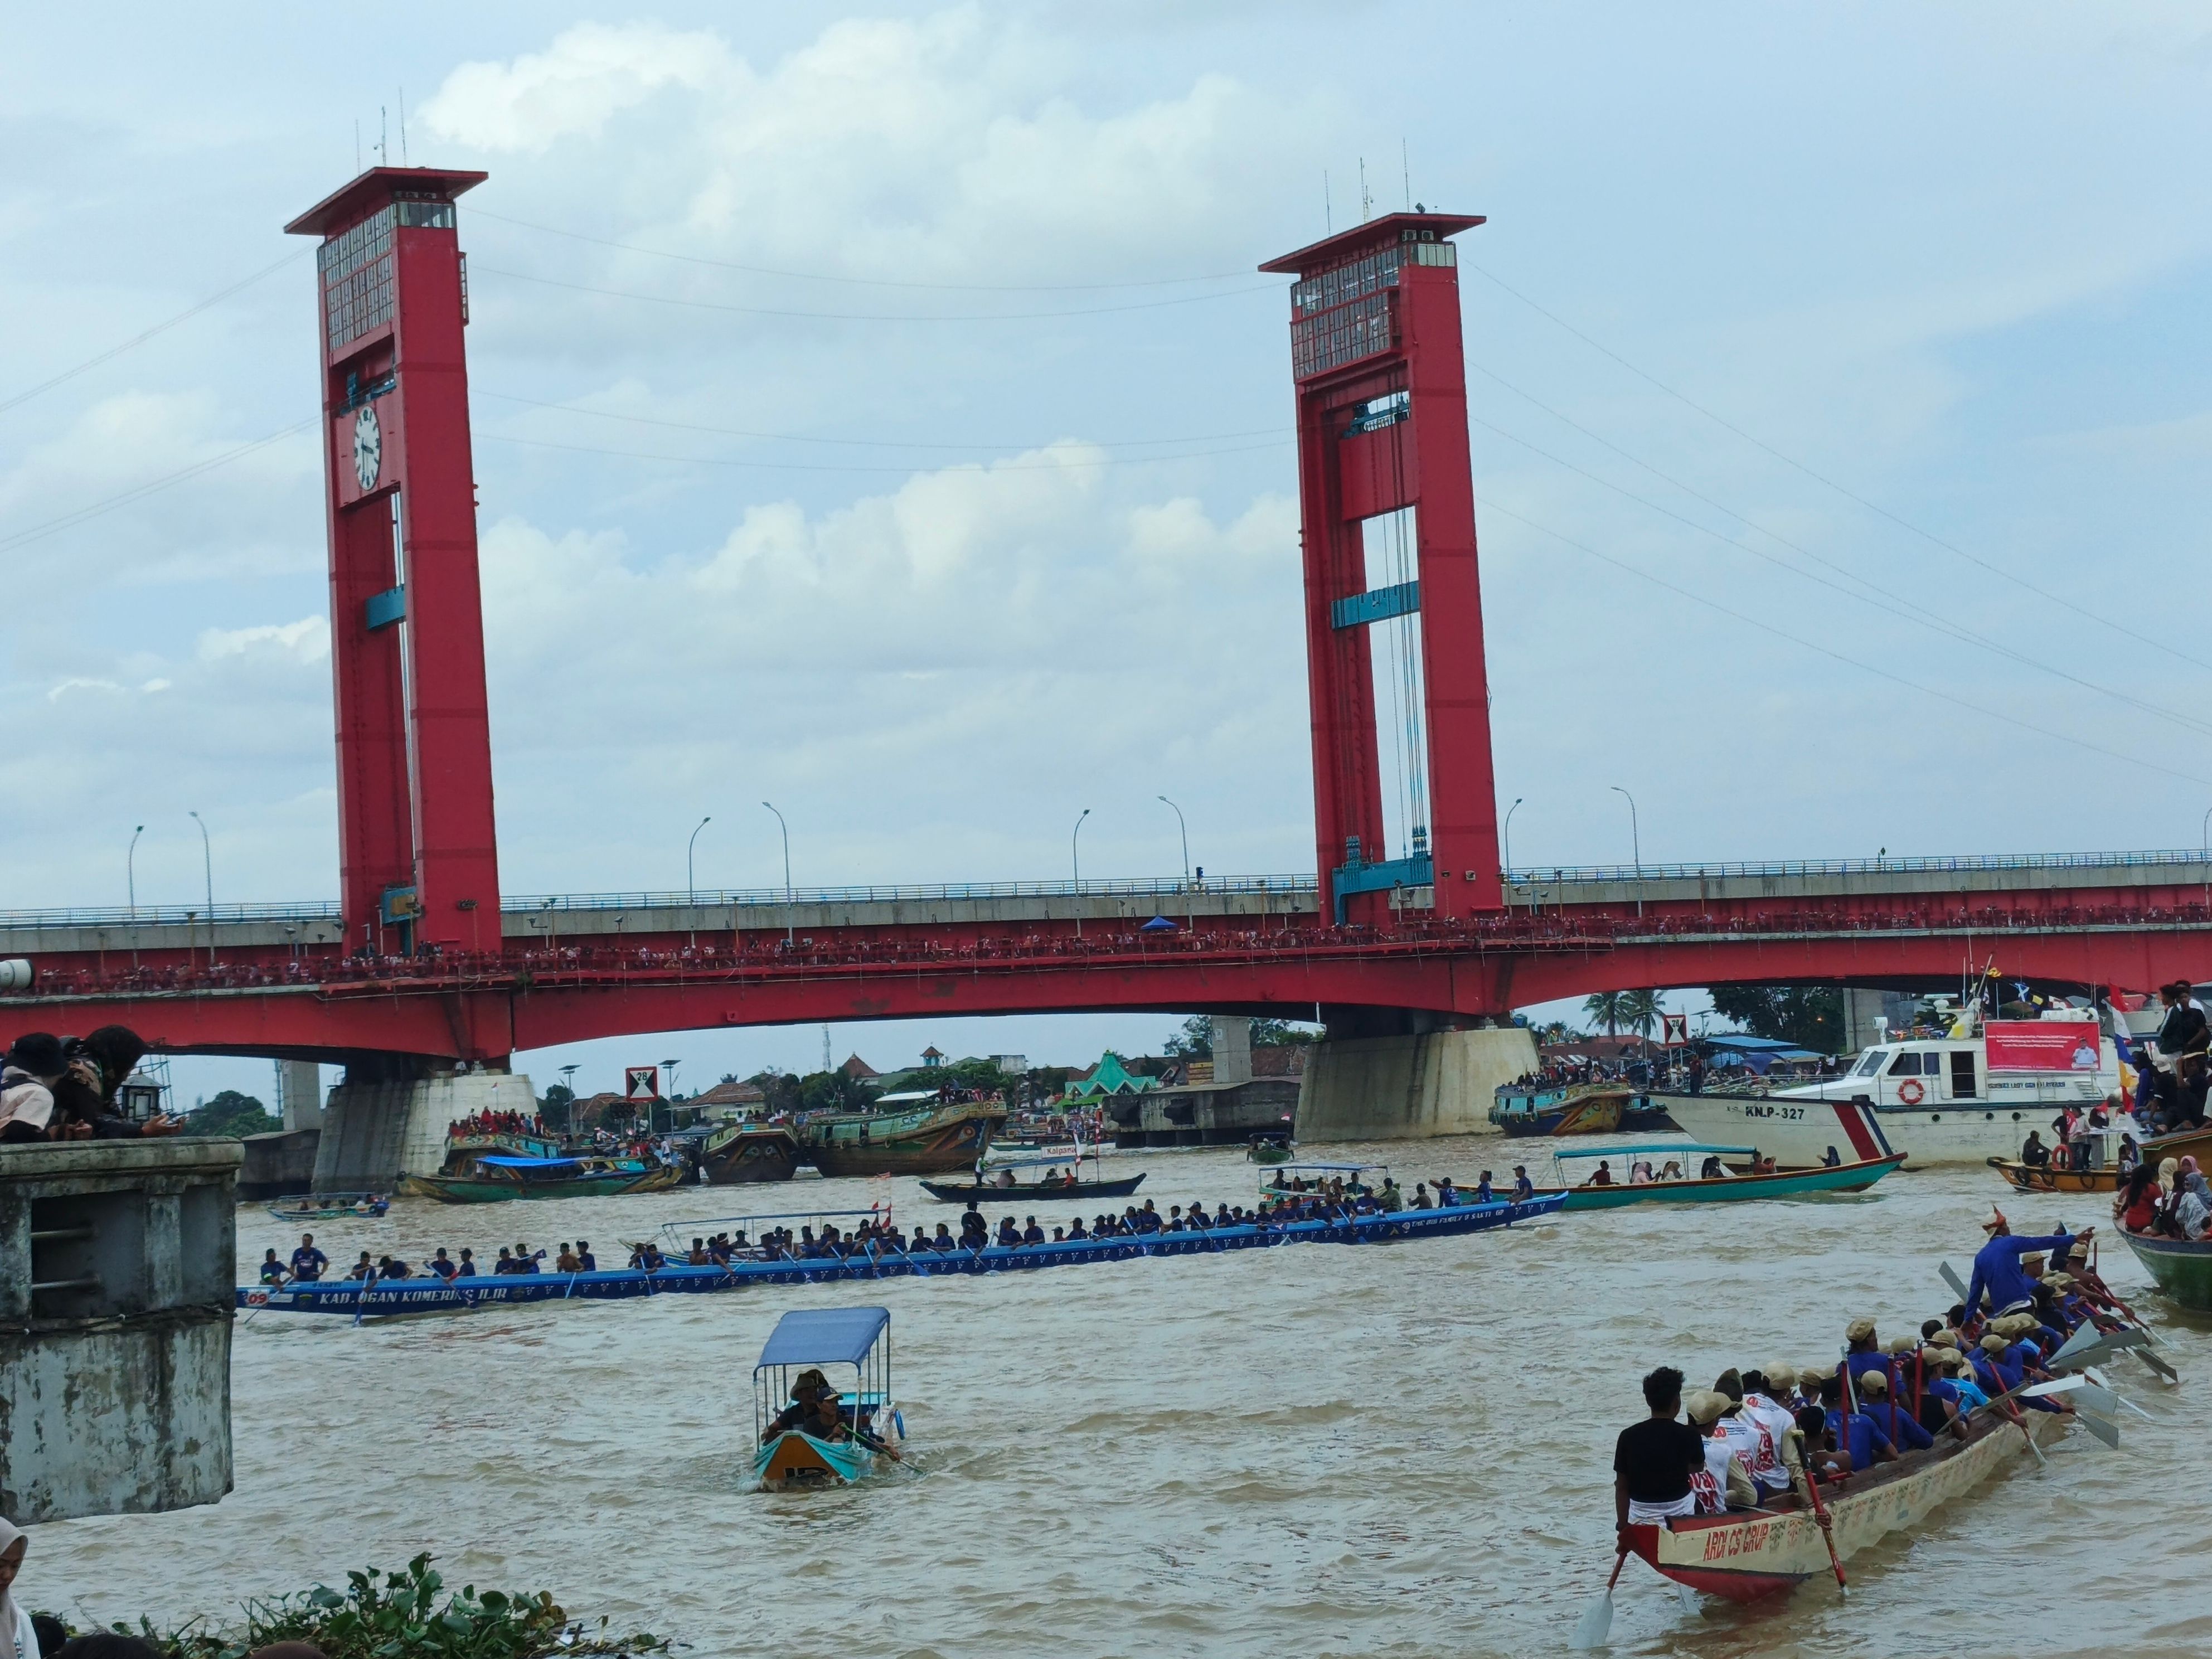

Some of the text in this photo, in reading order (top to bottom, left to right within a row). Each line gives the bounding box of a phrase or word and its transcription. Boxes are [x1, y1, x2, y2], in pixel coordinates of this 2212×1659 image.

[249, 1293, 267, 1304] 09
[478, 1288, 507, 1300] ILIR
[1703, 1523, 1769, 1561] ARDI CS GRUP
